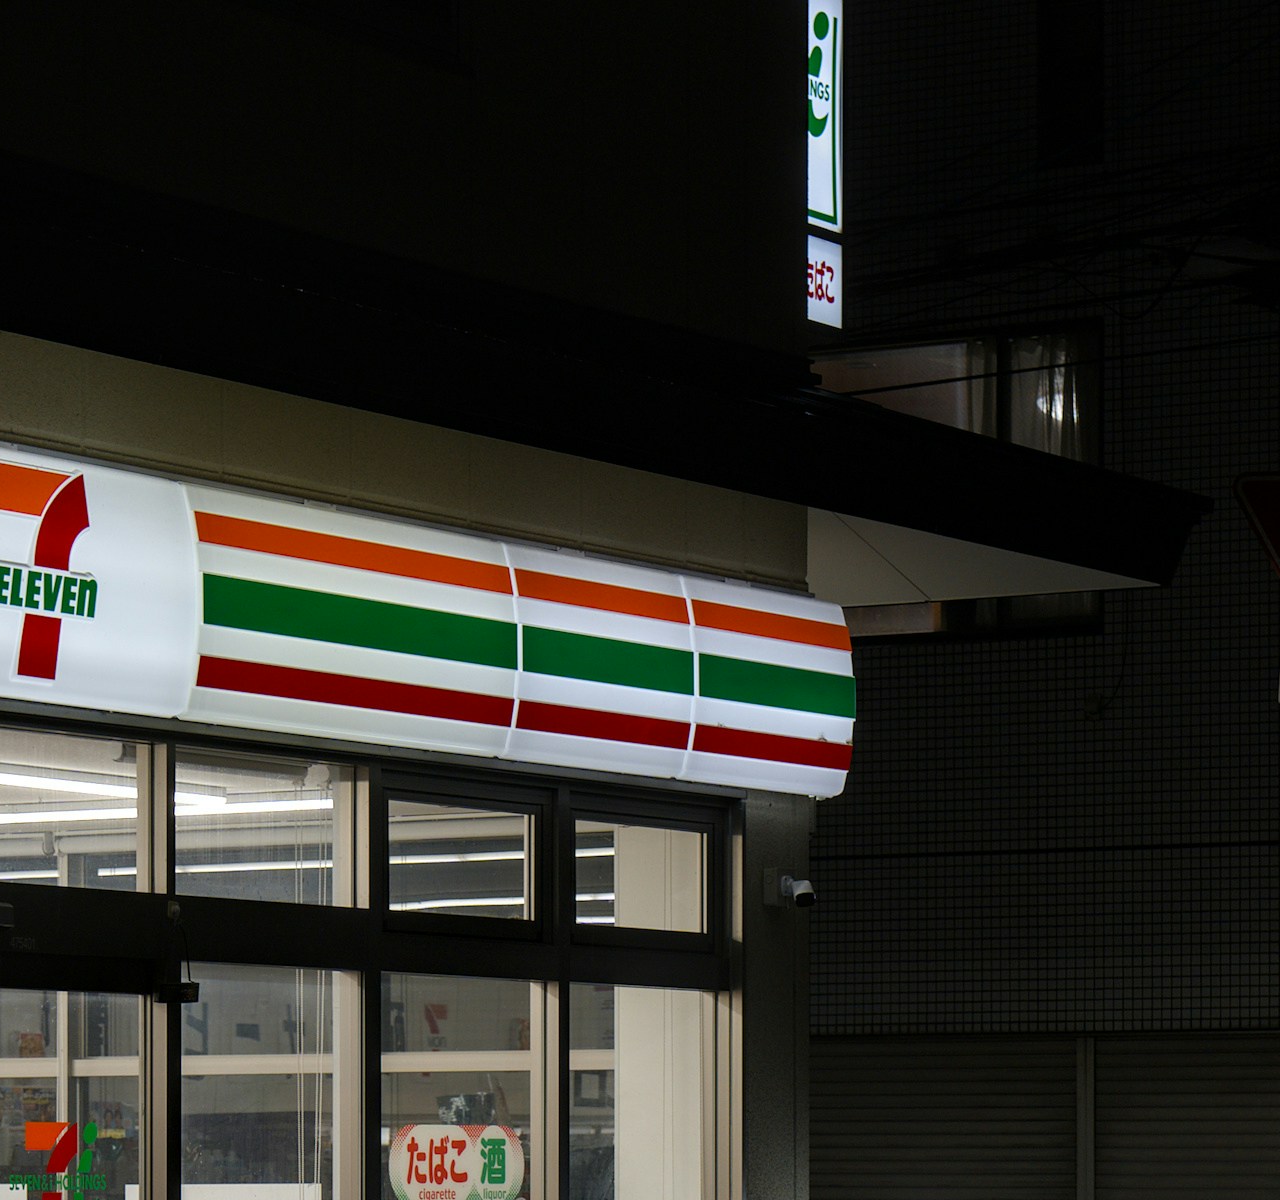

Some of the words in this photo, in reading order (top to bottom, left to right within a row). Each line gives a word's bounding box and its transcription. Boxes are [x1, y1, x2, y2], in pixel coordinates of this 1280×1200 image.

[407, 1135, 468, 1185] たばこ
[480, 1137, 507, 1185] 酒
[55, 1174, 107, 1191] HOLDINGS
[483, 1188, 507, 1200] liquor
